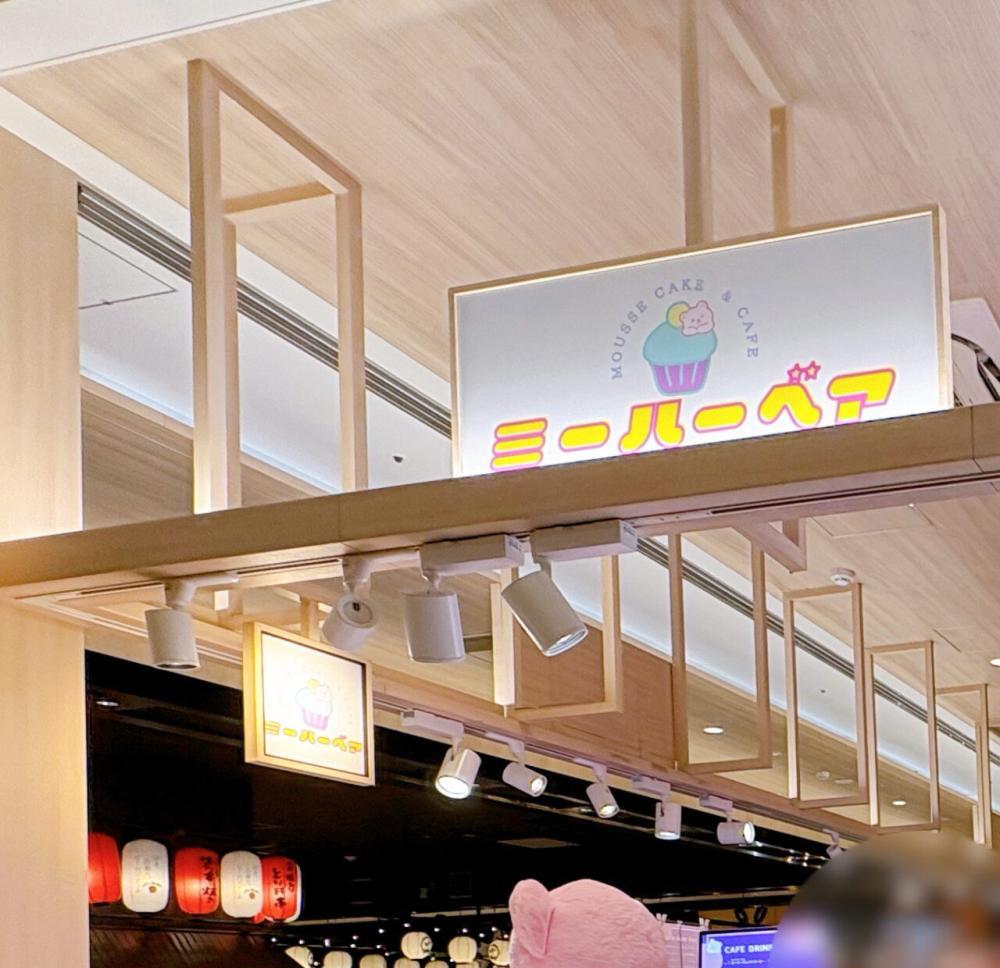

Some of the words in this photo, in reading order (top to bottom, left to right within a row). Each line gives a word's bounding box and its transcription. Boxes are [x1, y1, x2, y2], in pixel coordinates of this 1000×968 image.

[610, 300, 648, 380] MOUSSE
[654, 279, 704, 299] CAKE
[721, 289, 732, 303] &
[737, 307, 758, 358] CAFE
[490, 360, 896, 471] ミーハーベア
[724, 945, 745, 953] CAFE
